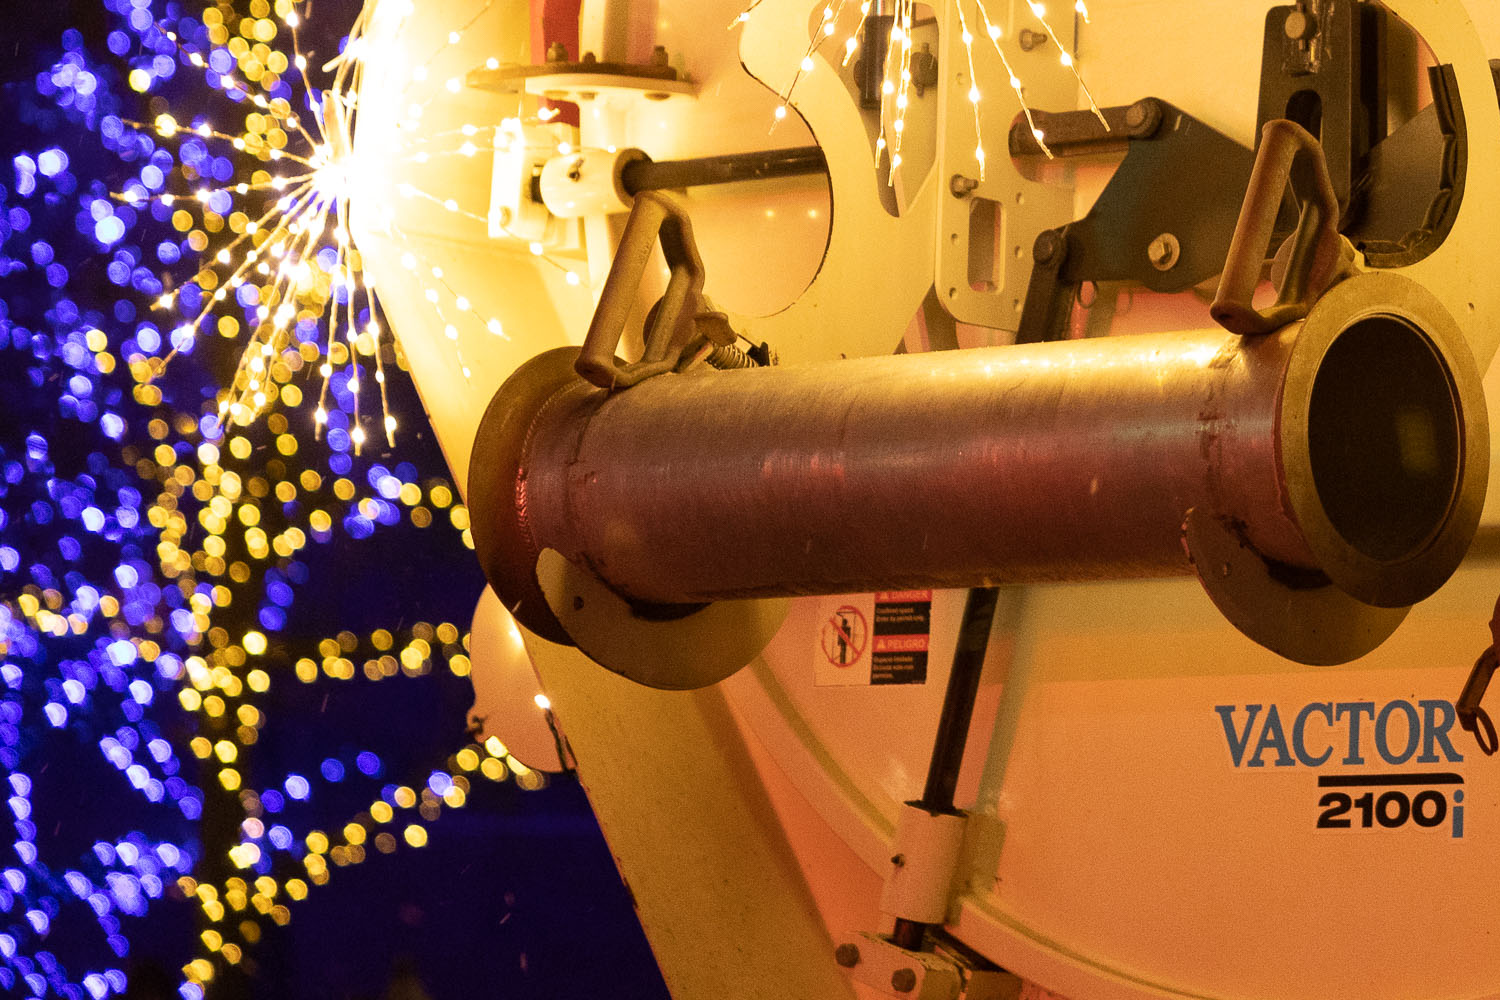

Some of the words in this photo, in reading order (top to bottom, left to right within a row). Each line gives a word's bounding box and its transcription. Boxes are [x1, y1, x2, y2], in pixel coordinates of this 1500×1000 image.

[888, 638, 925, 650] PELIGRO
[1215, 700, 1464, 768] VACTOR
[1316, 789, 1465, 838] 2100i
